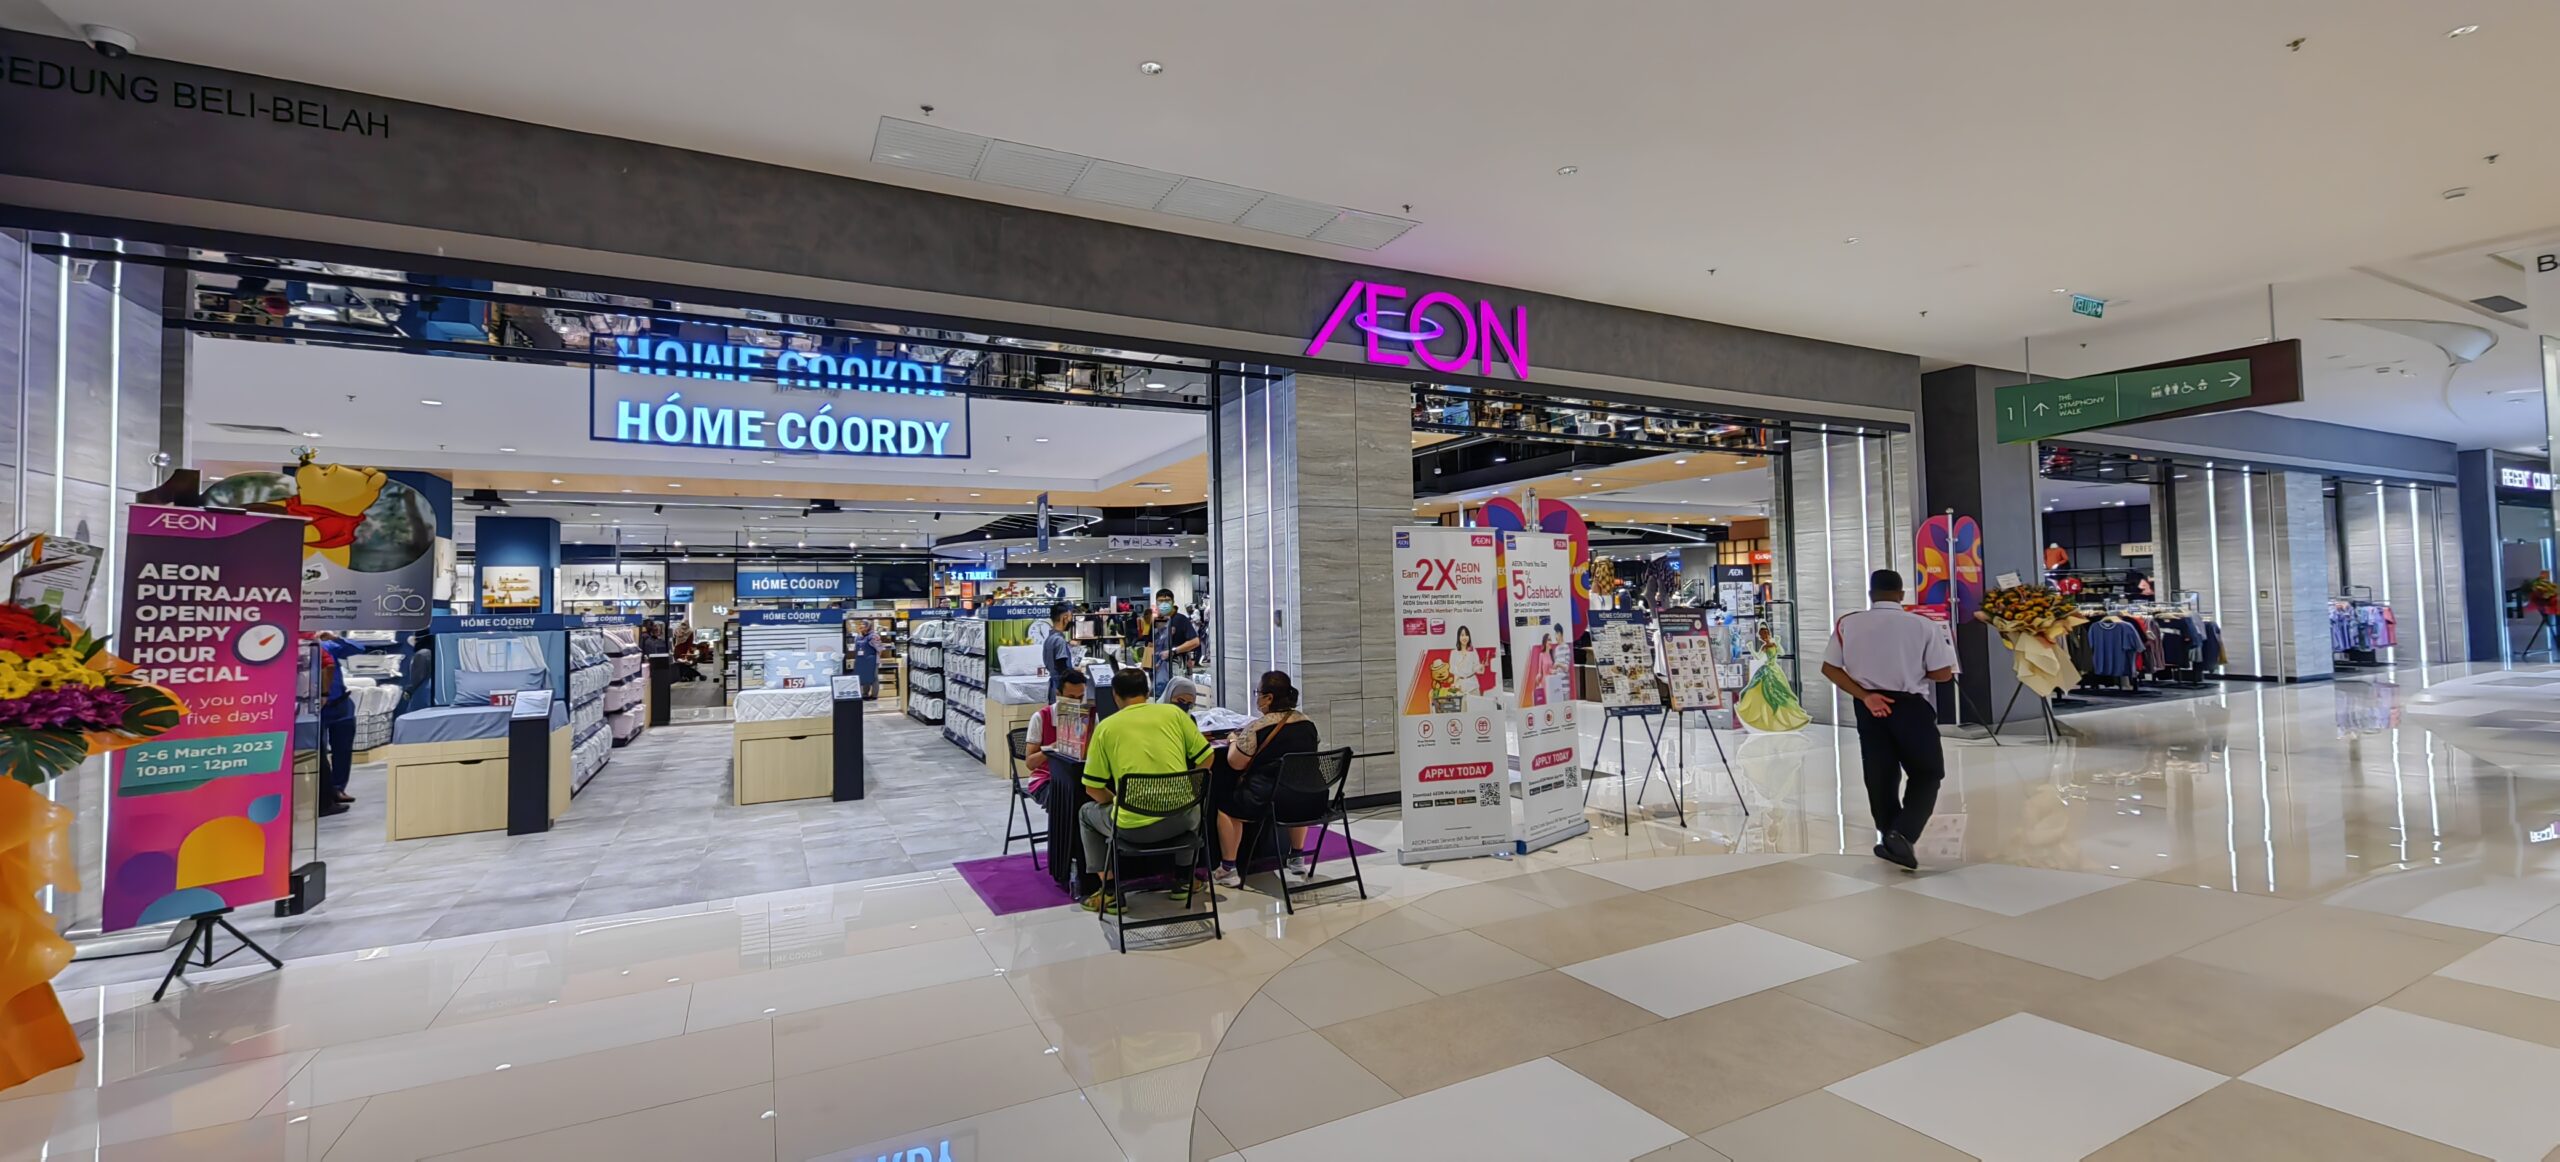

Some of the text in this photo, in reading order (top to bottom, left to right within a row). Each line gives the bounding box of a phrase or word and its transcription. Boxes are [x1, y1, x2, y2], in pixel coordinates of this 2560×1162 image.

[173, 81, 389, 138] BELI-BELAH
[2058, 396, 2105, 409] SYMPHONY
[2007, 407, 2013, 420] 1
[617, 391, 950, 455] HÓME CÓORDY
[137, 563, 220, 581] AEON
[1402, 559, 1458, 591] Earn 2X
[1455, 563, 1480, 573] AEON
[1456, 574, 1482, 585] Points
[137, 585, 292, 602] PUTRAJAYA
[1527, 585, 1563, 599] Cashback
[373, 594, 426, 612] 100
[135, 605, 261, 622] OPENING
[134, 626, 231, 642] HAPPY
[132, 646, 216, 664] HOUR
[132, 666, 249, 684] SPECIAL
[200, 696, 234, 709] you
[240, 692, 278, 707] only
[187, 708, 274, 725] five days!
[137, 740, 273, 763] 2-6 March 2023
[136, 764, 186, 777] 10am
[204, 757, 248, 771] 12pm
[1535, 755, 1552, 767] APPLY
[1424, 765, 1487, 779] APPLY TODAY
